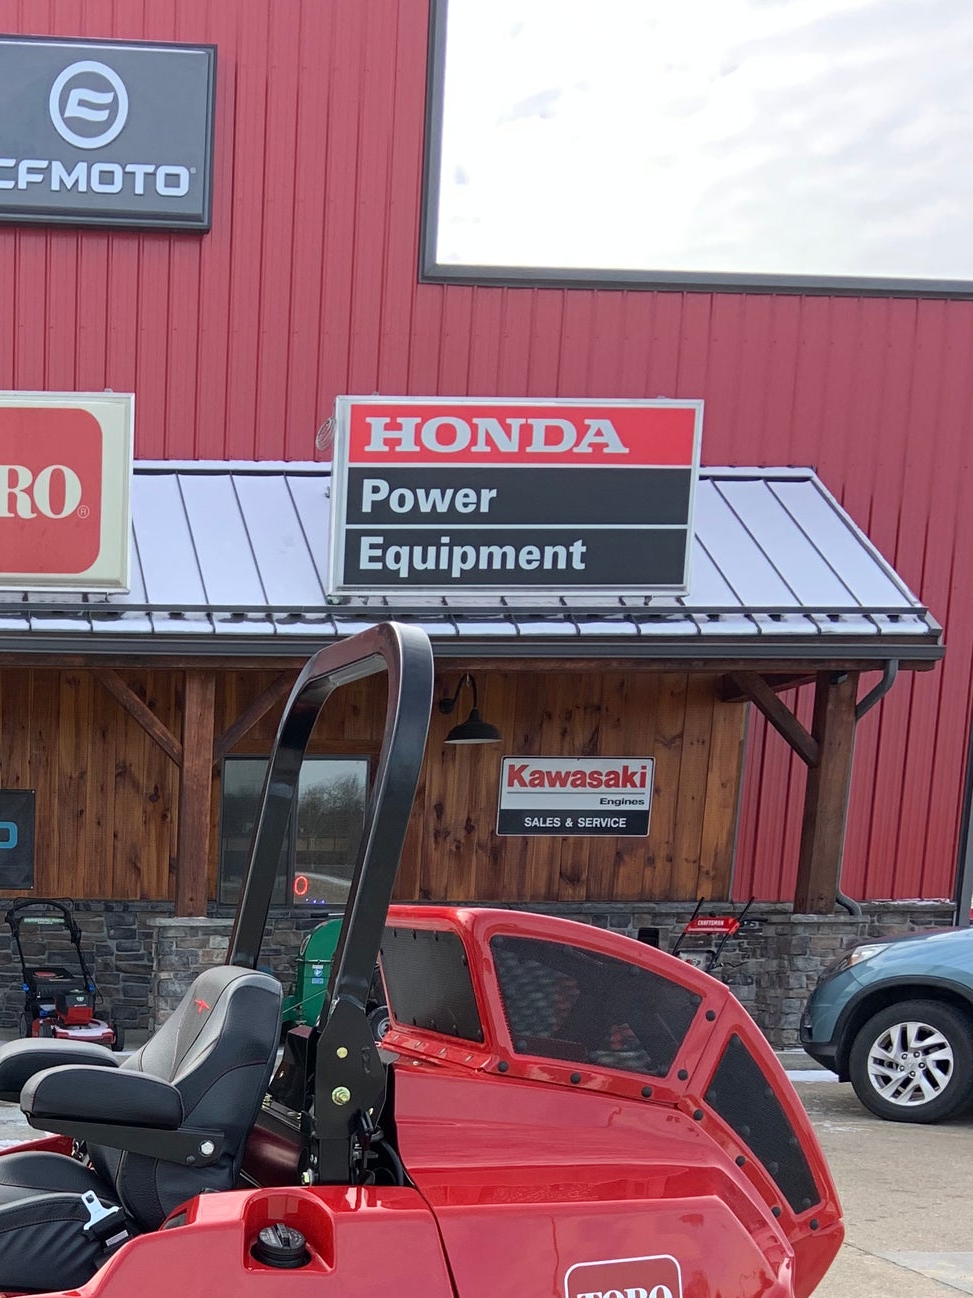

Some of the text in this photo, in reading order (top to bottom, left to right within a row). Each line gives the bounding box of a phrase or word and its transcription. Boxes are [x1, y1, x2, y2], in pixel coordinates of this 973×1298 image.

[364, 416, 629, 454] HONDA
[361, 478, 497, 513] Power
[359, 536, 587, 578] Equipment
[507, 764, 647, 789] Kawasaki
[600, 797, 645, 807] Engines
[524, 817, 627, 828] SALES & SERVICE
